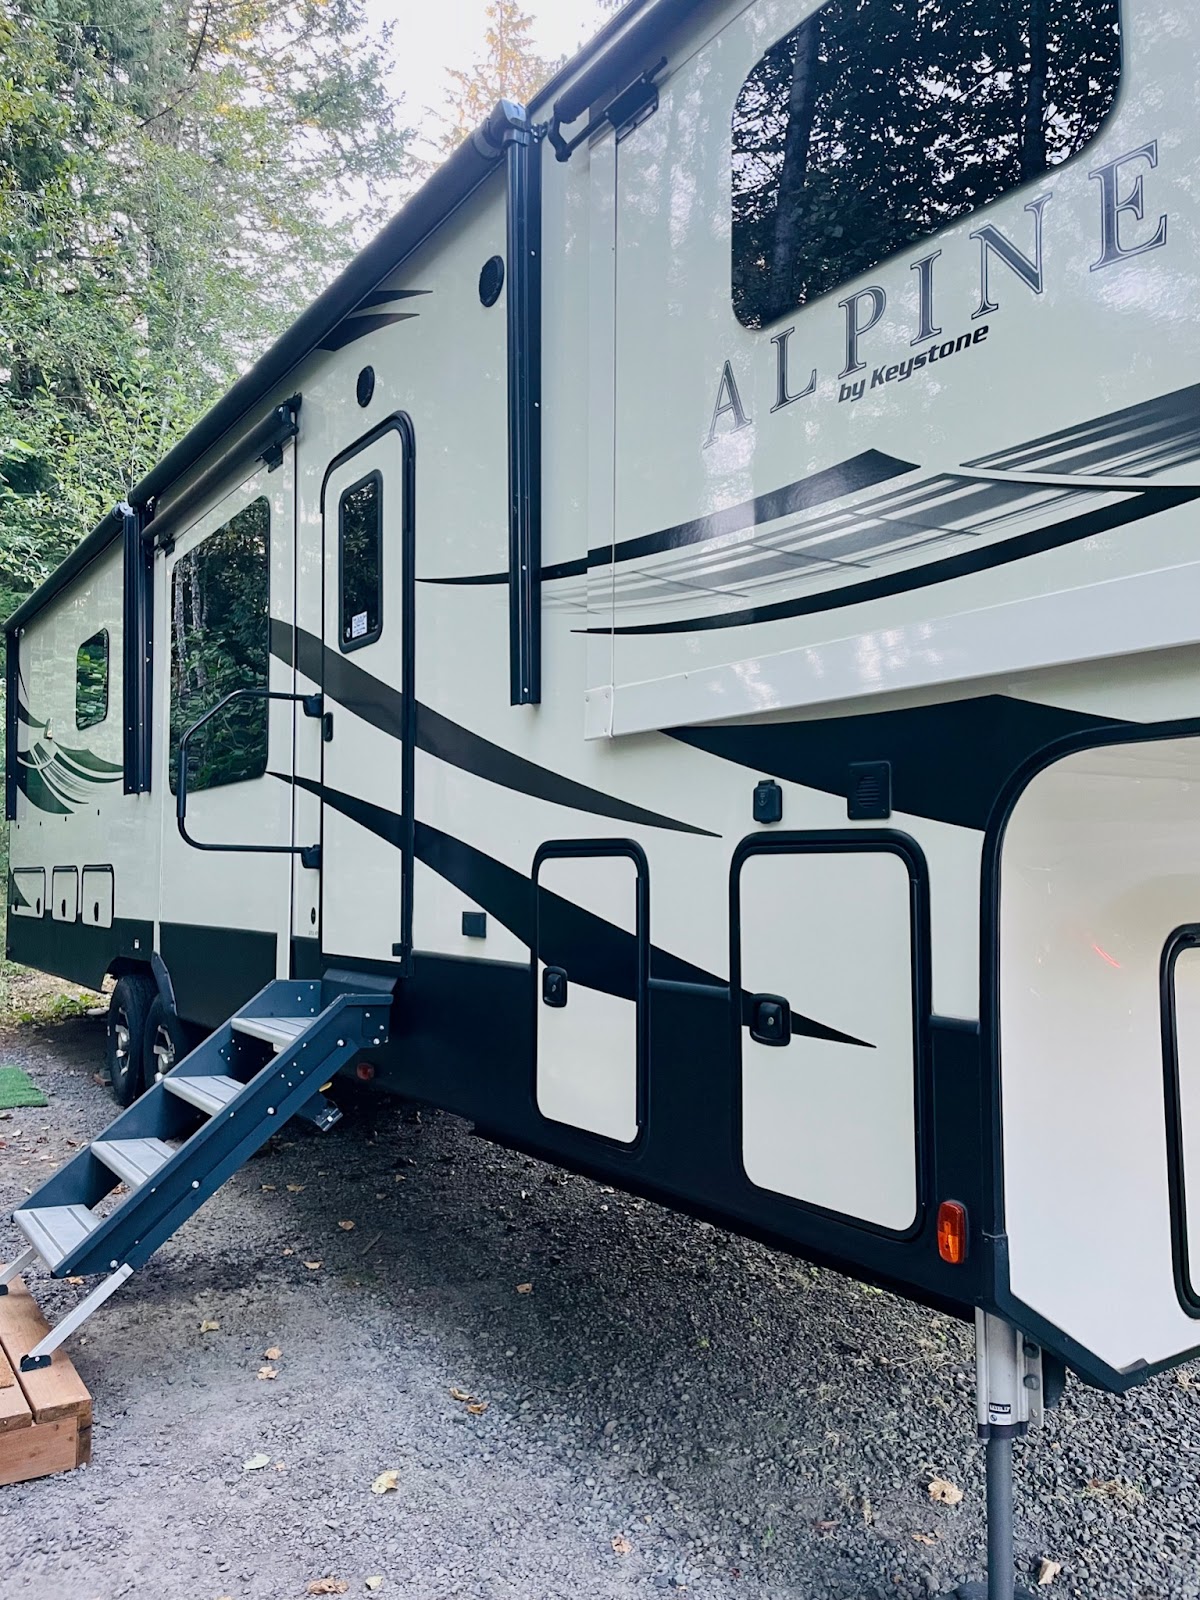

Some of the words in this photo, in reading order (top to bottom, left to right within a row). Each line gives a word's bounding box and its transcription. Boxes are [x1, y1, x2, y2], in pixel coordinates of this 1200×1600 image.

[703, 138, 1168, 449] ALPINE
[838, 378, 866, 403] by
[869, 324, 989, 389] Keystone
